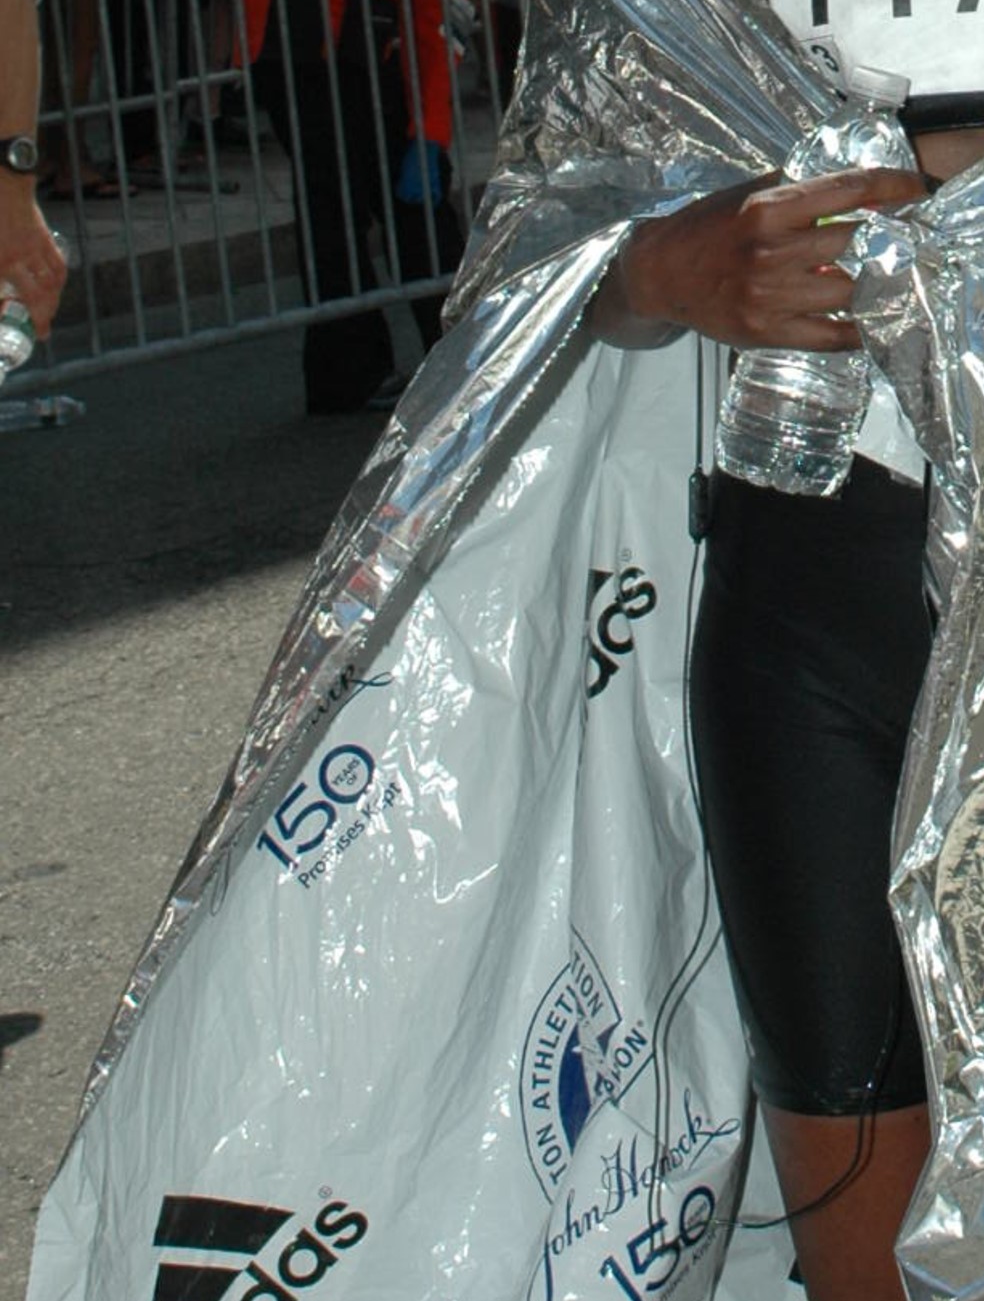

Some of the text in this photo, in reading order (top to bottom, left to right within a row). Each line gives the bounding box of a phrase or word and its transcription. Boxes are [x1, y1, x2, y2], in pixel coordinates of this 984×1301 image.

[332, 757, 362, 787] YEARS
[345, 774, 359, 787] OF
[256, 743, 376, 871] 150
[363, 780, 403, 821] Kpt
[599, 1185, 715, 1301] 150
